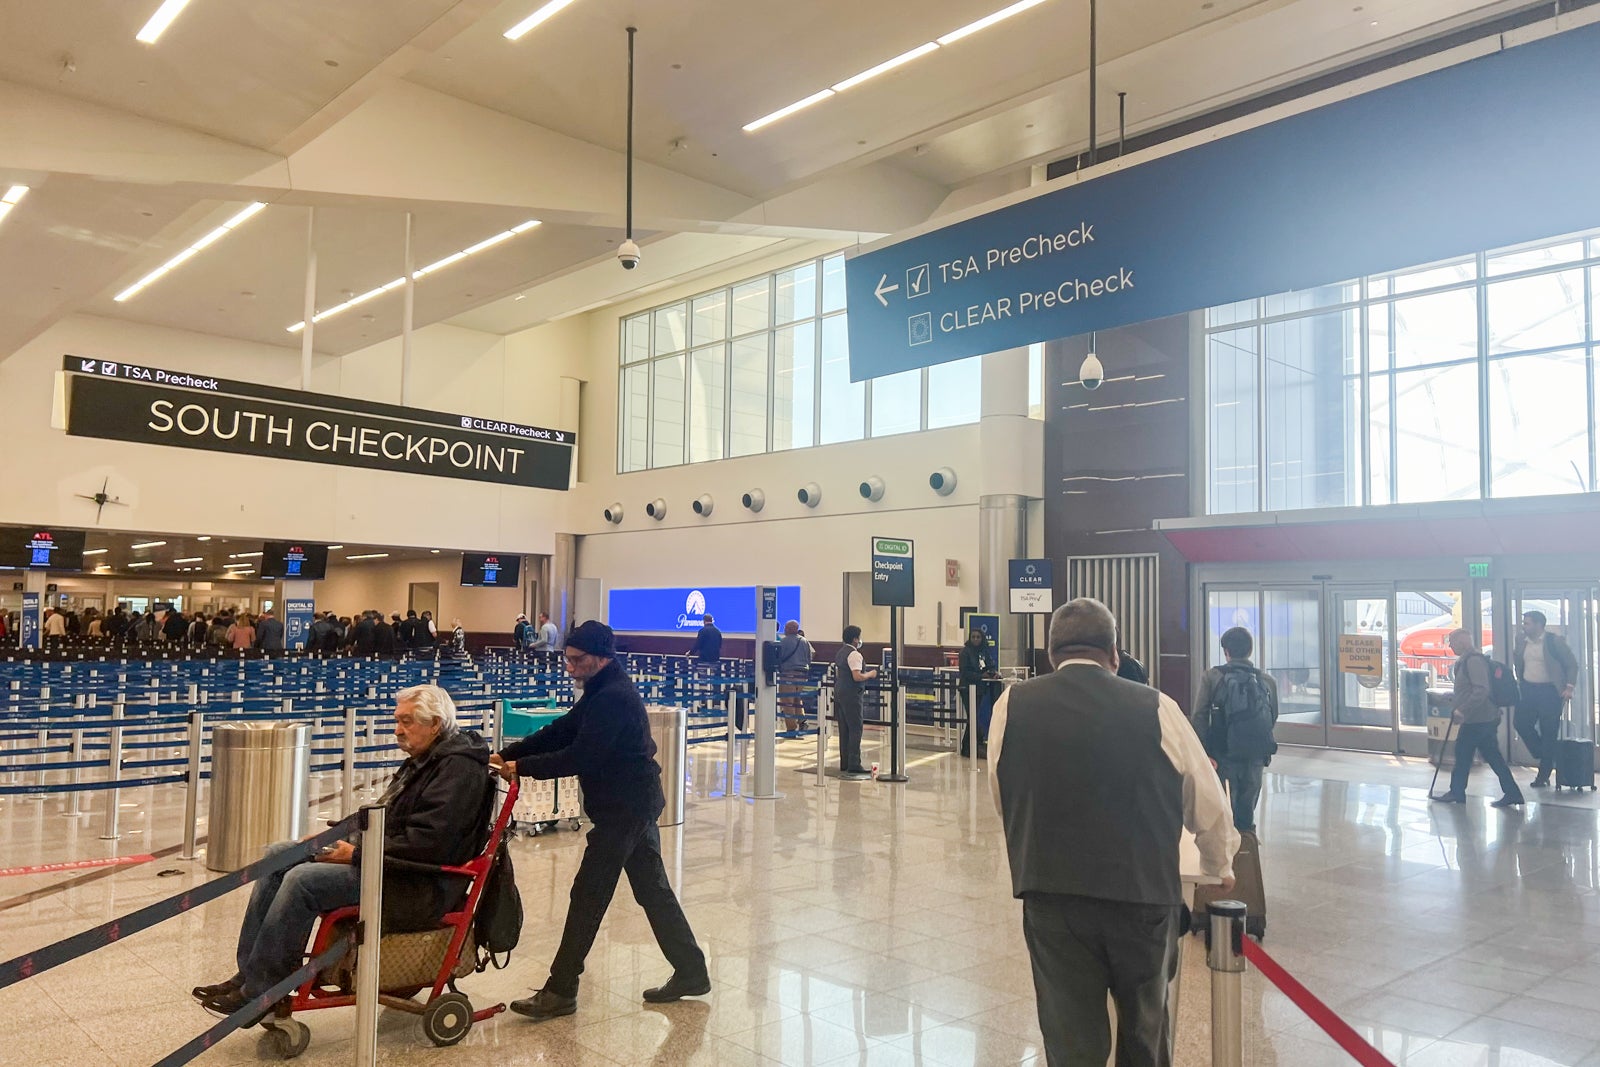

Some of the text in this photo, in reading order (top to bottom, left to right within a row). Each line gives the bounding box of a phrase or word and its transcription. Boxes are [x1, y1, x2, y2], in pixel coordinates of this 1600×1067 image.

[938, 222, 1095, 283] TSA PreCheck
[940, 267, 1135, 333] CLEAR PreCheck
[123, 365, 218, 390] TSA Precheck
[148, 400, 525, 474] SOUTH CHECKPOINT
[473, 419, 551, 439] CLEAR Precheck
[874, 560, 904, 571] Checkpoint
[1469, 563, 1489, 576] EXIT
[874, 572, 889, 582] Entry
